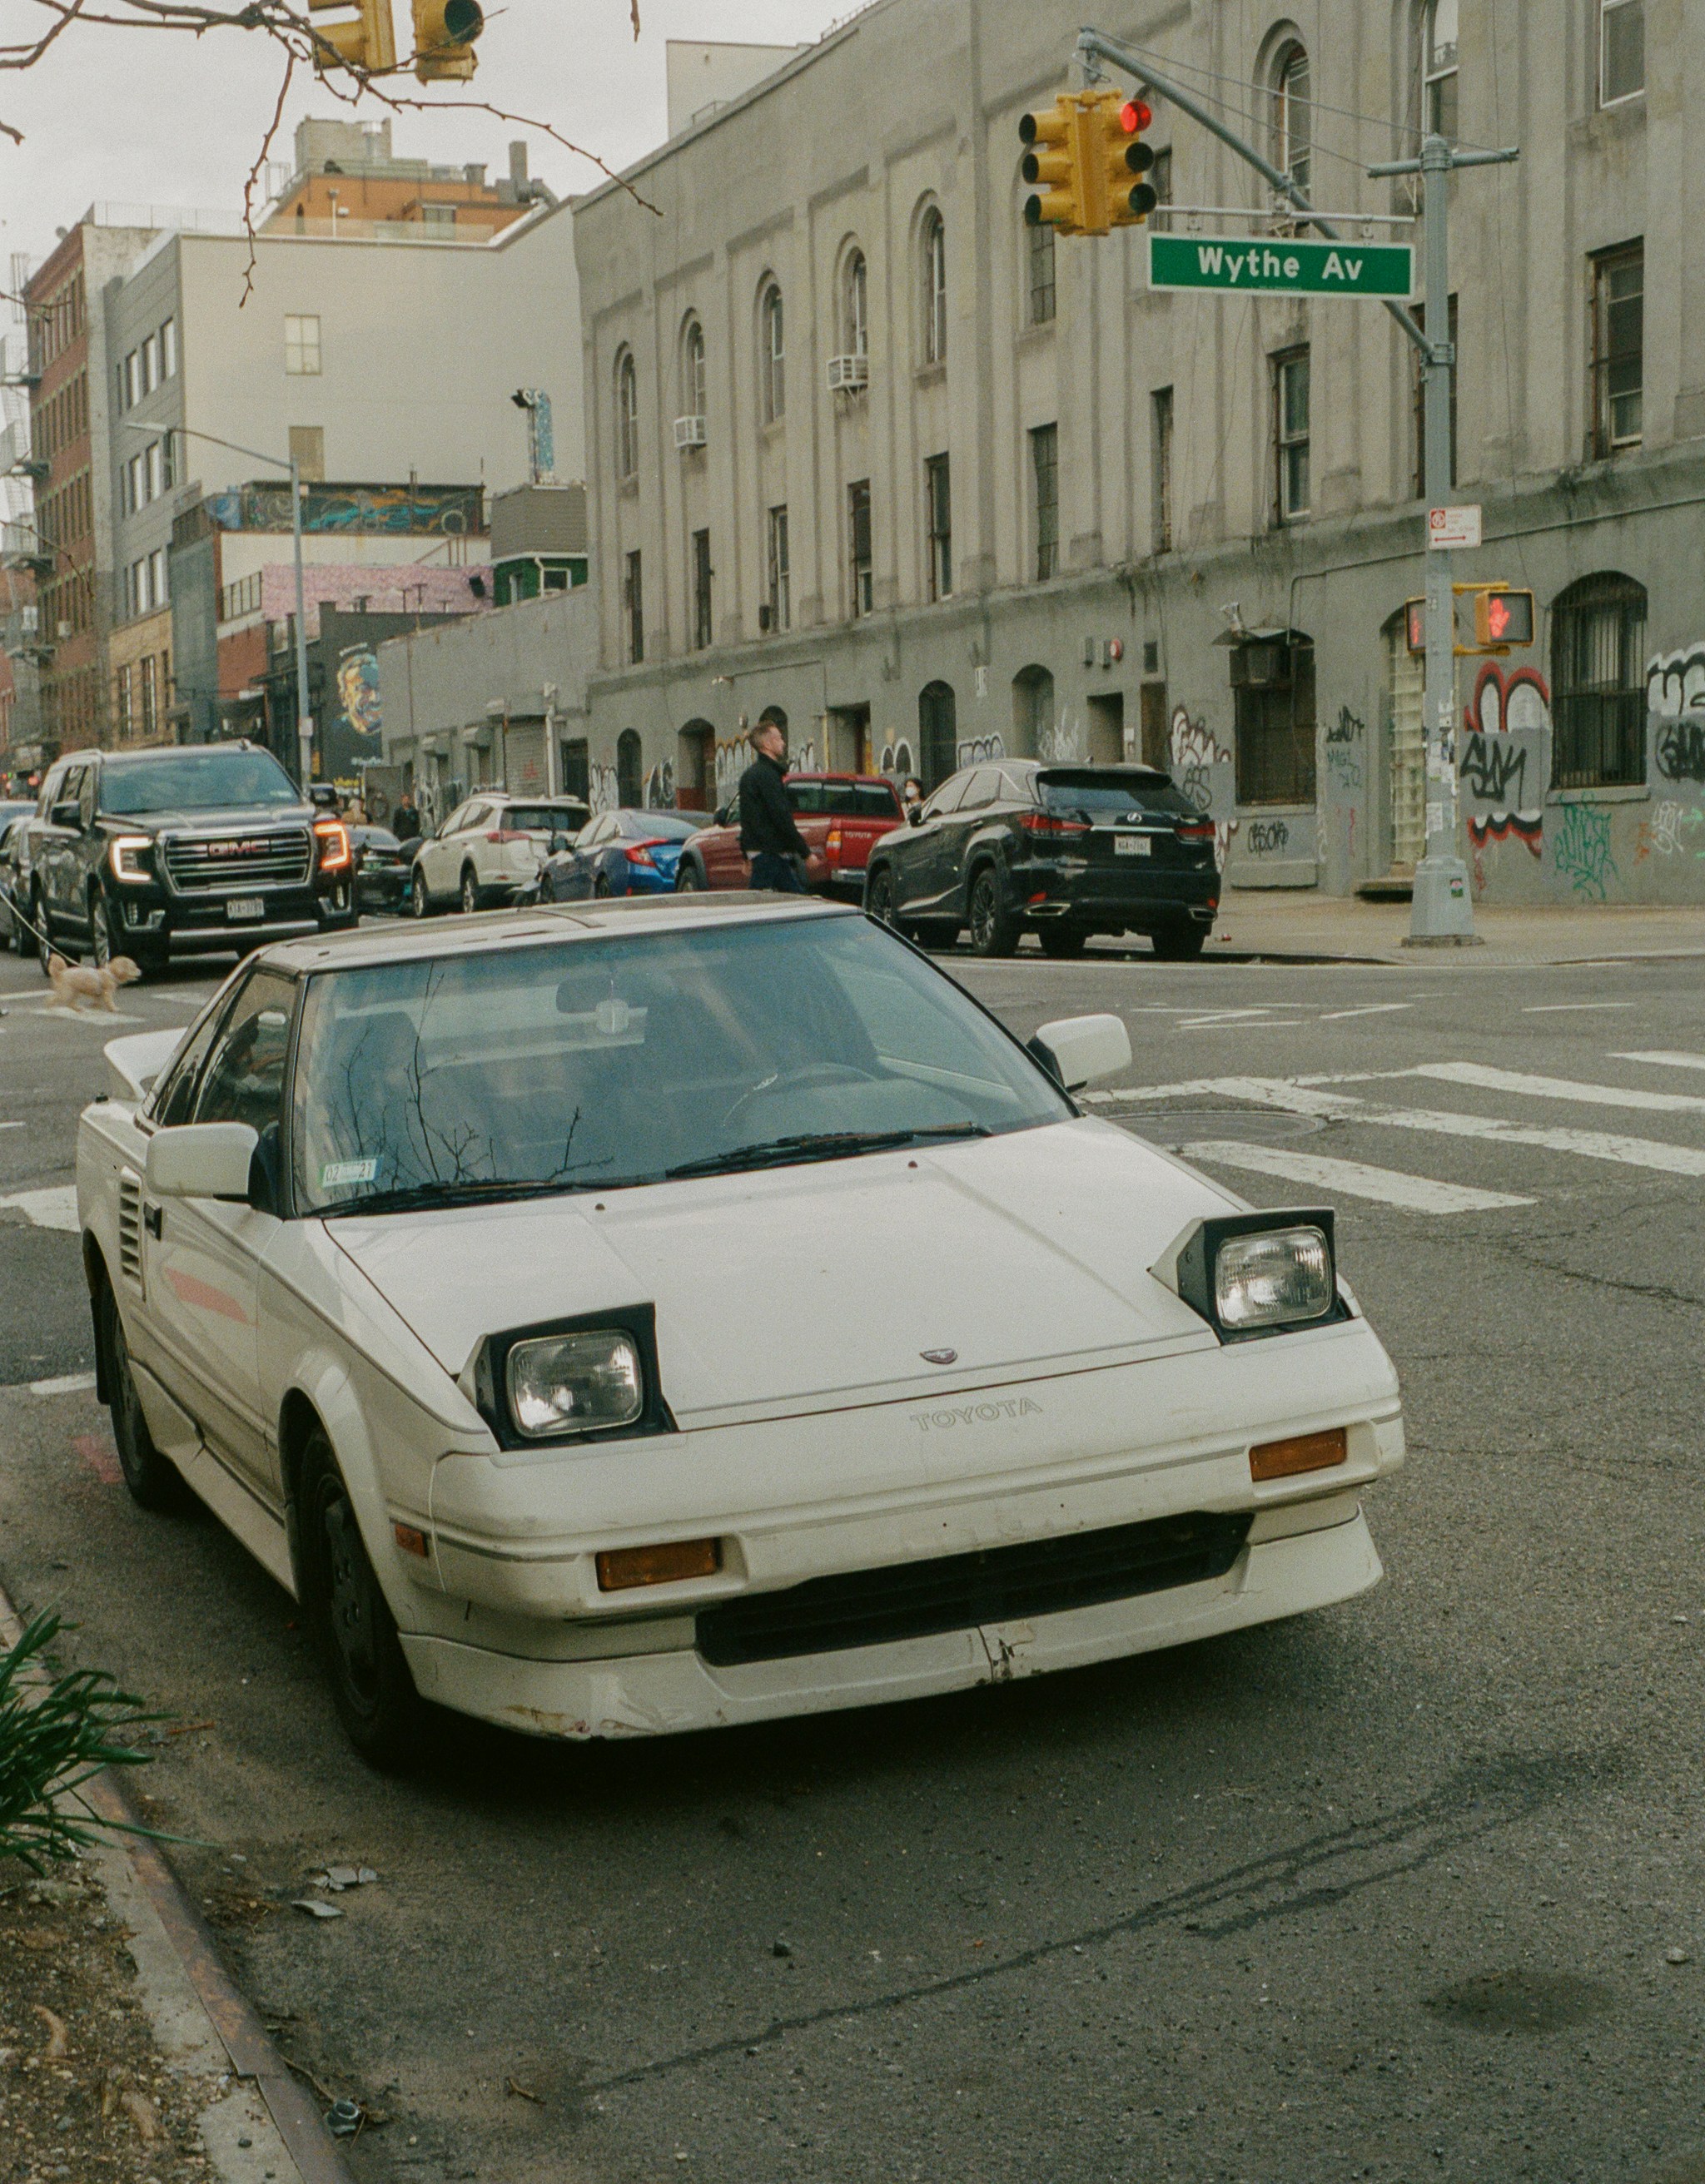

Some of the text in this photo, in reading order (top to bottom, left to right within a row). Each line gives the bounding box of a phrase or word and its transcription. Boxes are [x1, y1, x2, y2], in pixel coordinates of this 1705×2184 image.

[1197, 246, 1364, 284] Wythe Av
[844, 831, 872, 839] TOYOTA
[208, 839, 270, 857] GMC
[326, 1165, 340, 1182] 02
[909, 1397, 1044, 1432] TOYOTA
